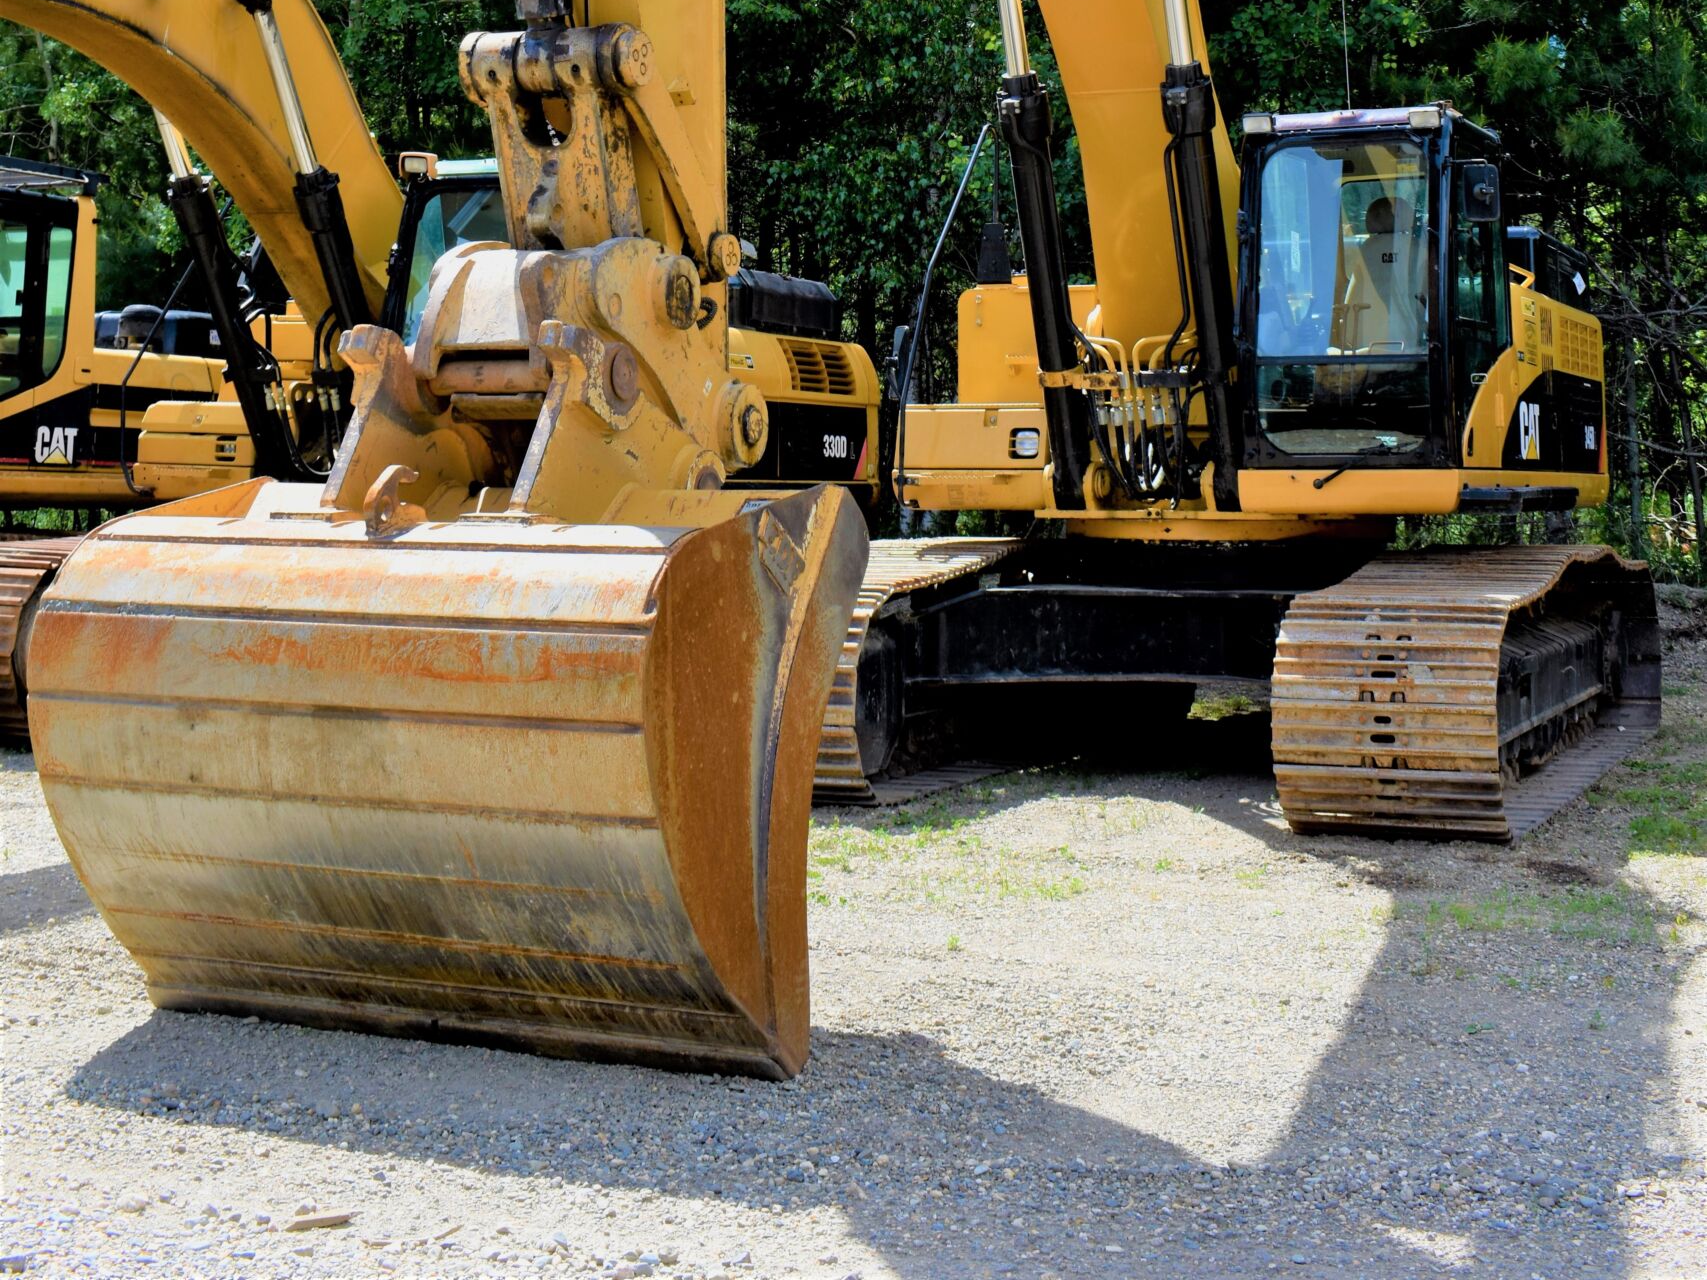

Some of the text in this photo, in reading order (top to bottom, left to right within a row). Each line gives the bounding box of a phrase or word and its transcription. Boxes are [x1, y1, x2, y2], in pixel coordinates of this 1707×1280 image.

[1382, 252, 1399, 263] CAT
[34, 425, 79, 464] CAT
[823, 434, 847, 458] 330D
[1519, 401, 1540, 460] CAT
